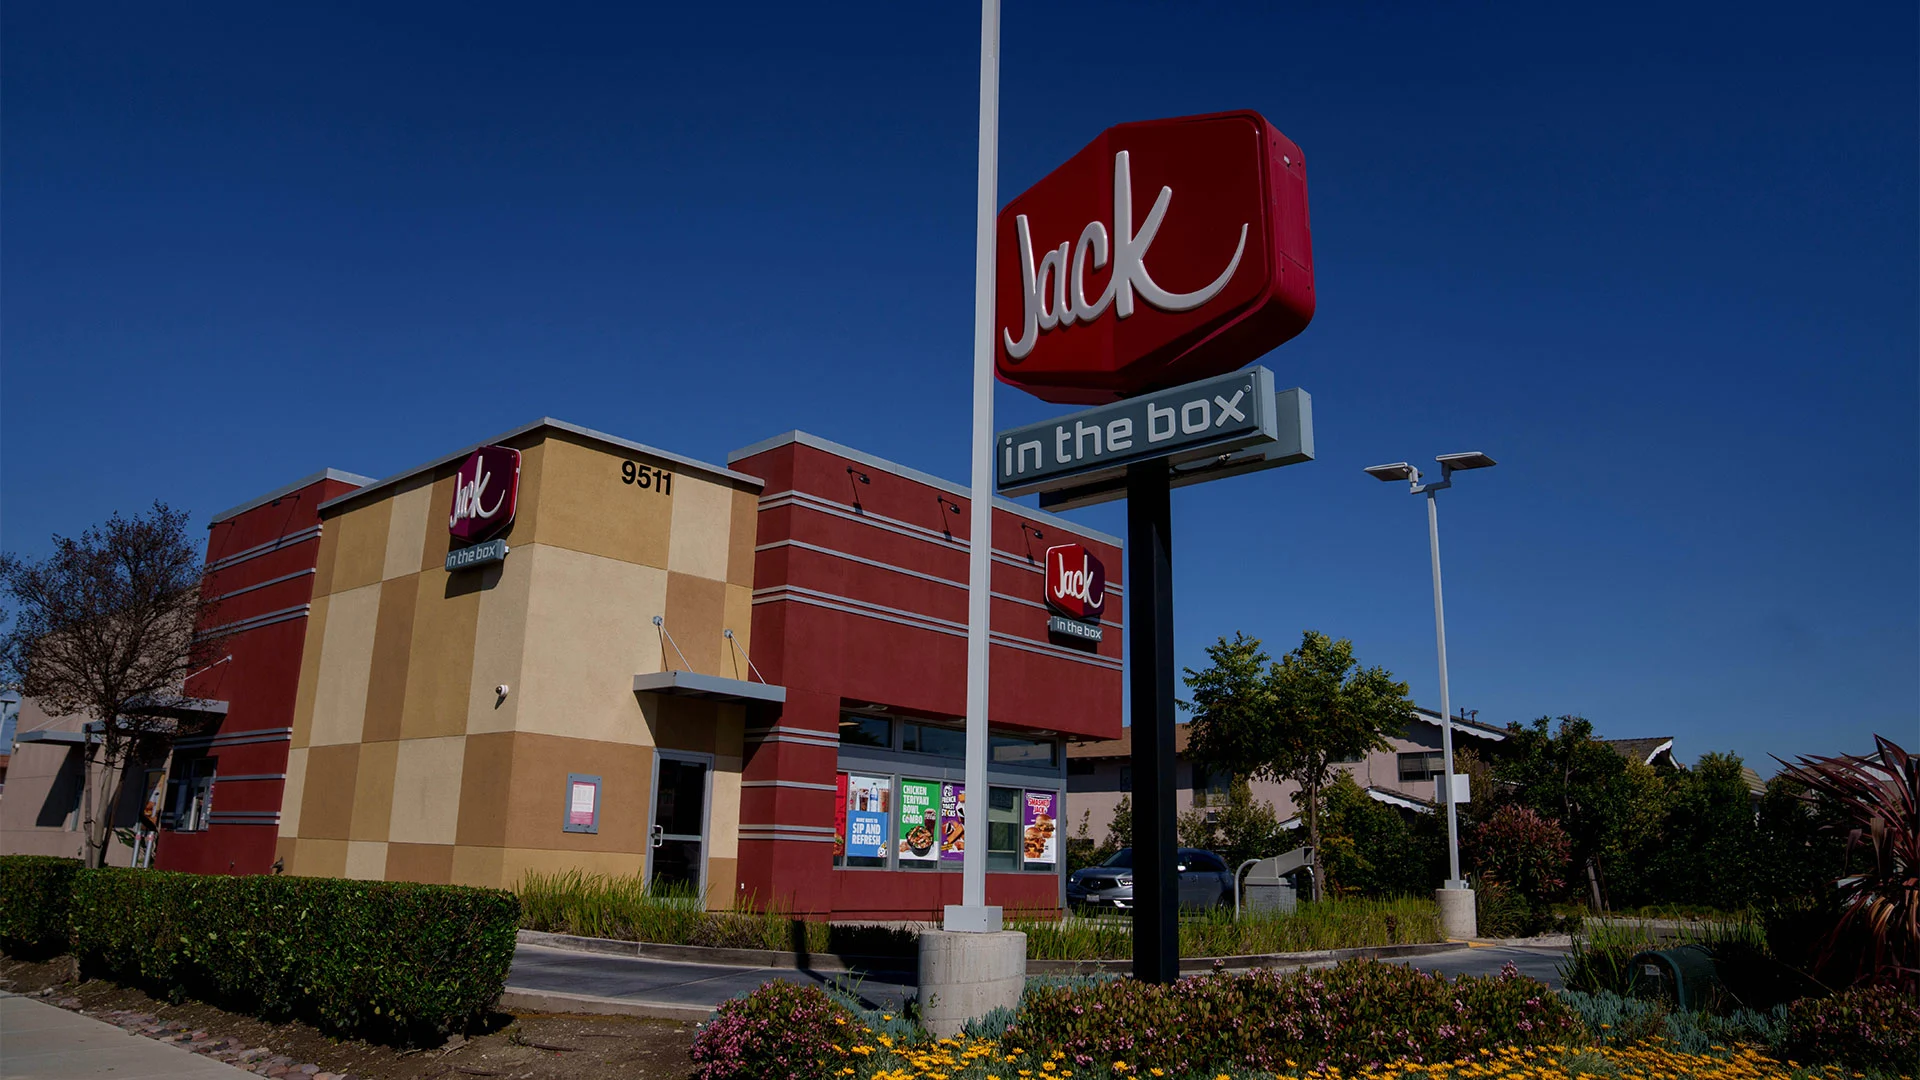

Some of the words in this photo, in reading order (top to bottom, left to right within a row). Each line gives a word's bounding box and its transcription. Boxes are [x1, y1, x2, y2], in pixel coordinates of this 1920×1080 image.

[1003, 150, 1249, 359] Jack
[1005, 437, 1042, 477] in
[1056, 418, 1133, 464] the
[621, 460, 672, 496] 9511
[449, 455, 506, 528] Jack
[446, 553, 457, 568] in
[457, 550, 475, 565] the
[475, 545, 496, 560] box
[1054, 552, 1104, 608] Jack
[1056, 618, 1066, 631] in
[1067, 620, 1083, 635] the
[1084, 627, 1102, 639] box
[903, 785, 927, 796] CHICKEN
[903, 794, 930, 806] TERIYAKI
[902, 804, 920, 815] BOWL
[1028, 798, 1050, 808] SMASHED
[852, 822, 865, 834] SIP
[865, 823, 881, 835] AND
[851, 834, 881, 845] REFRESH
